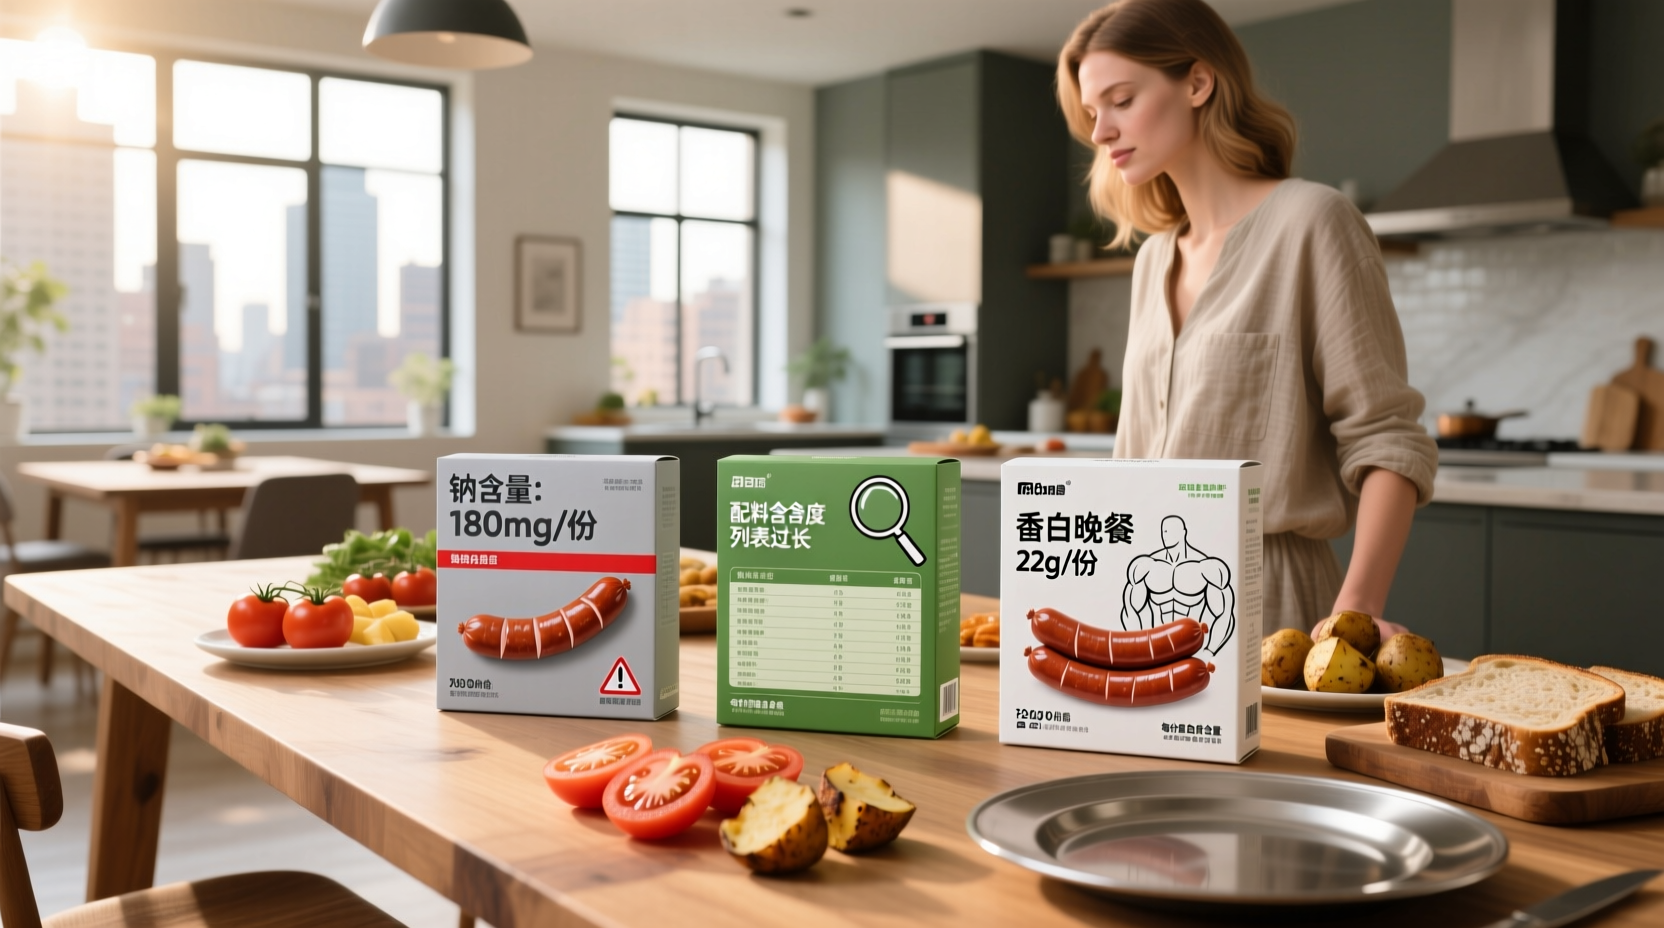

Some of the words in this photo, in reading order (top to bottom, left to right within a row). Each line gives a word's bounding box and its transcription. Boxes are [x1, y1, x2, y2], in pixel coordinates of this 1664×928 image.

[449, 508, 598, 547] 180mg/份
[729, 525, 812, 550] 列表过长
[1015, 548, 1098, 580] 22g/份
